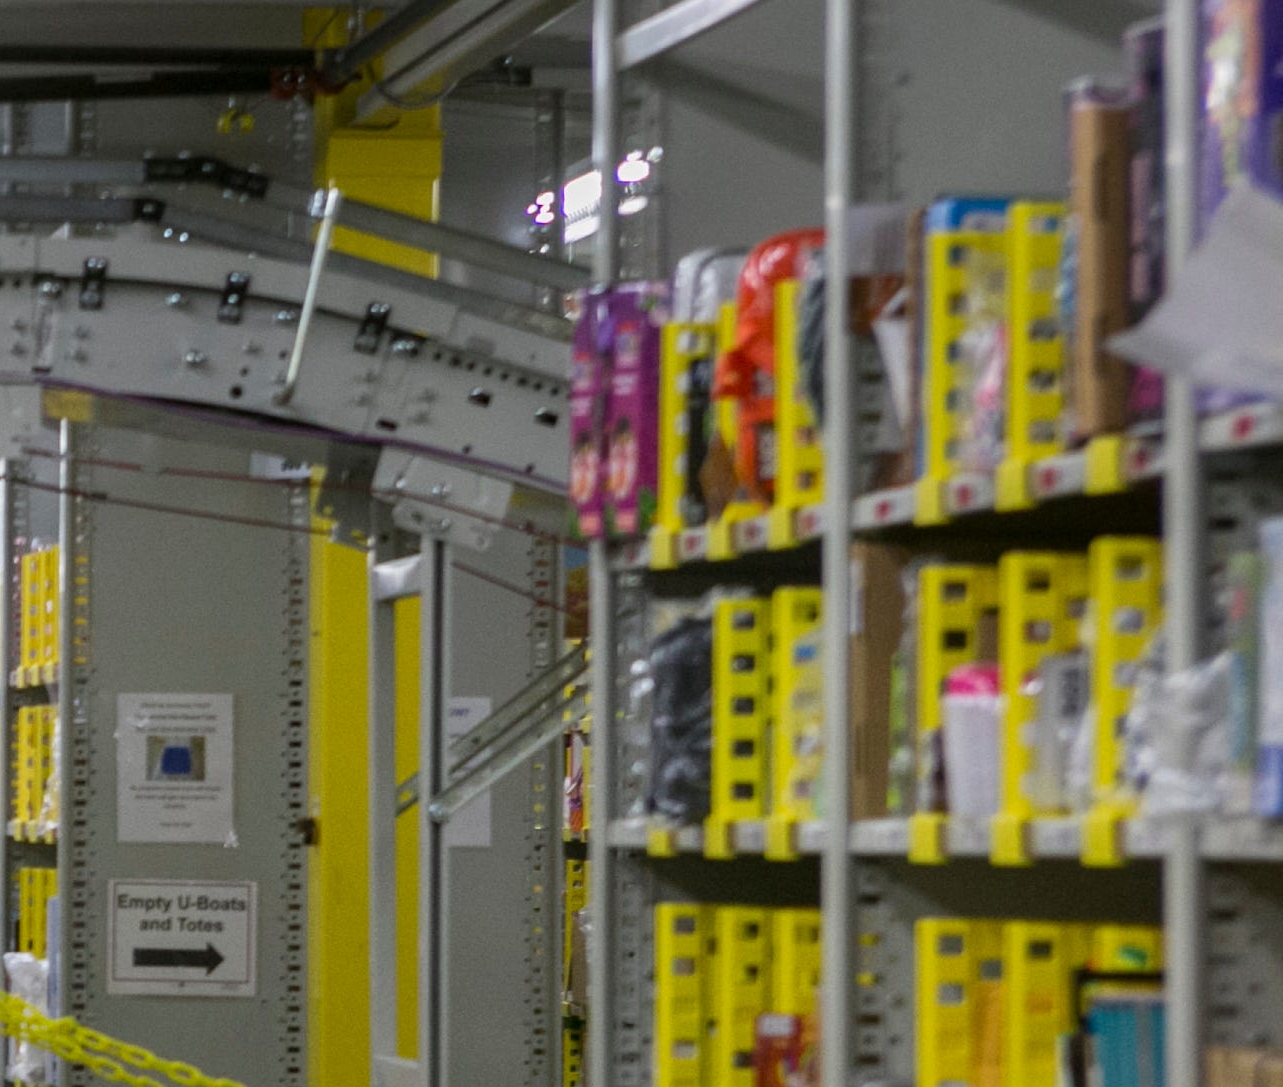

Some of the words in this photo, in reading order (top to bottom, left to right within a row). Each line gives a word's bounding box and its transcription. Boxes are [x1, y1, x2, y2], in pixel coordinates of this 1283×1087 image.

[117, 893, 172, 912] Empty
[177, 894, 246, 912] U-Boats
[139, 918, 173, 931] and
[177, 917, 224, 932] Totes
